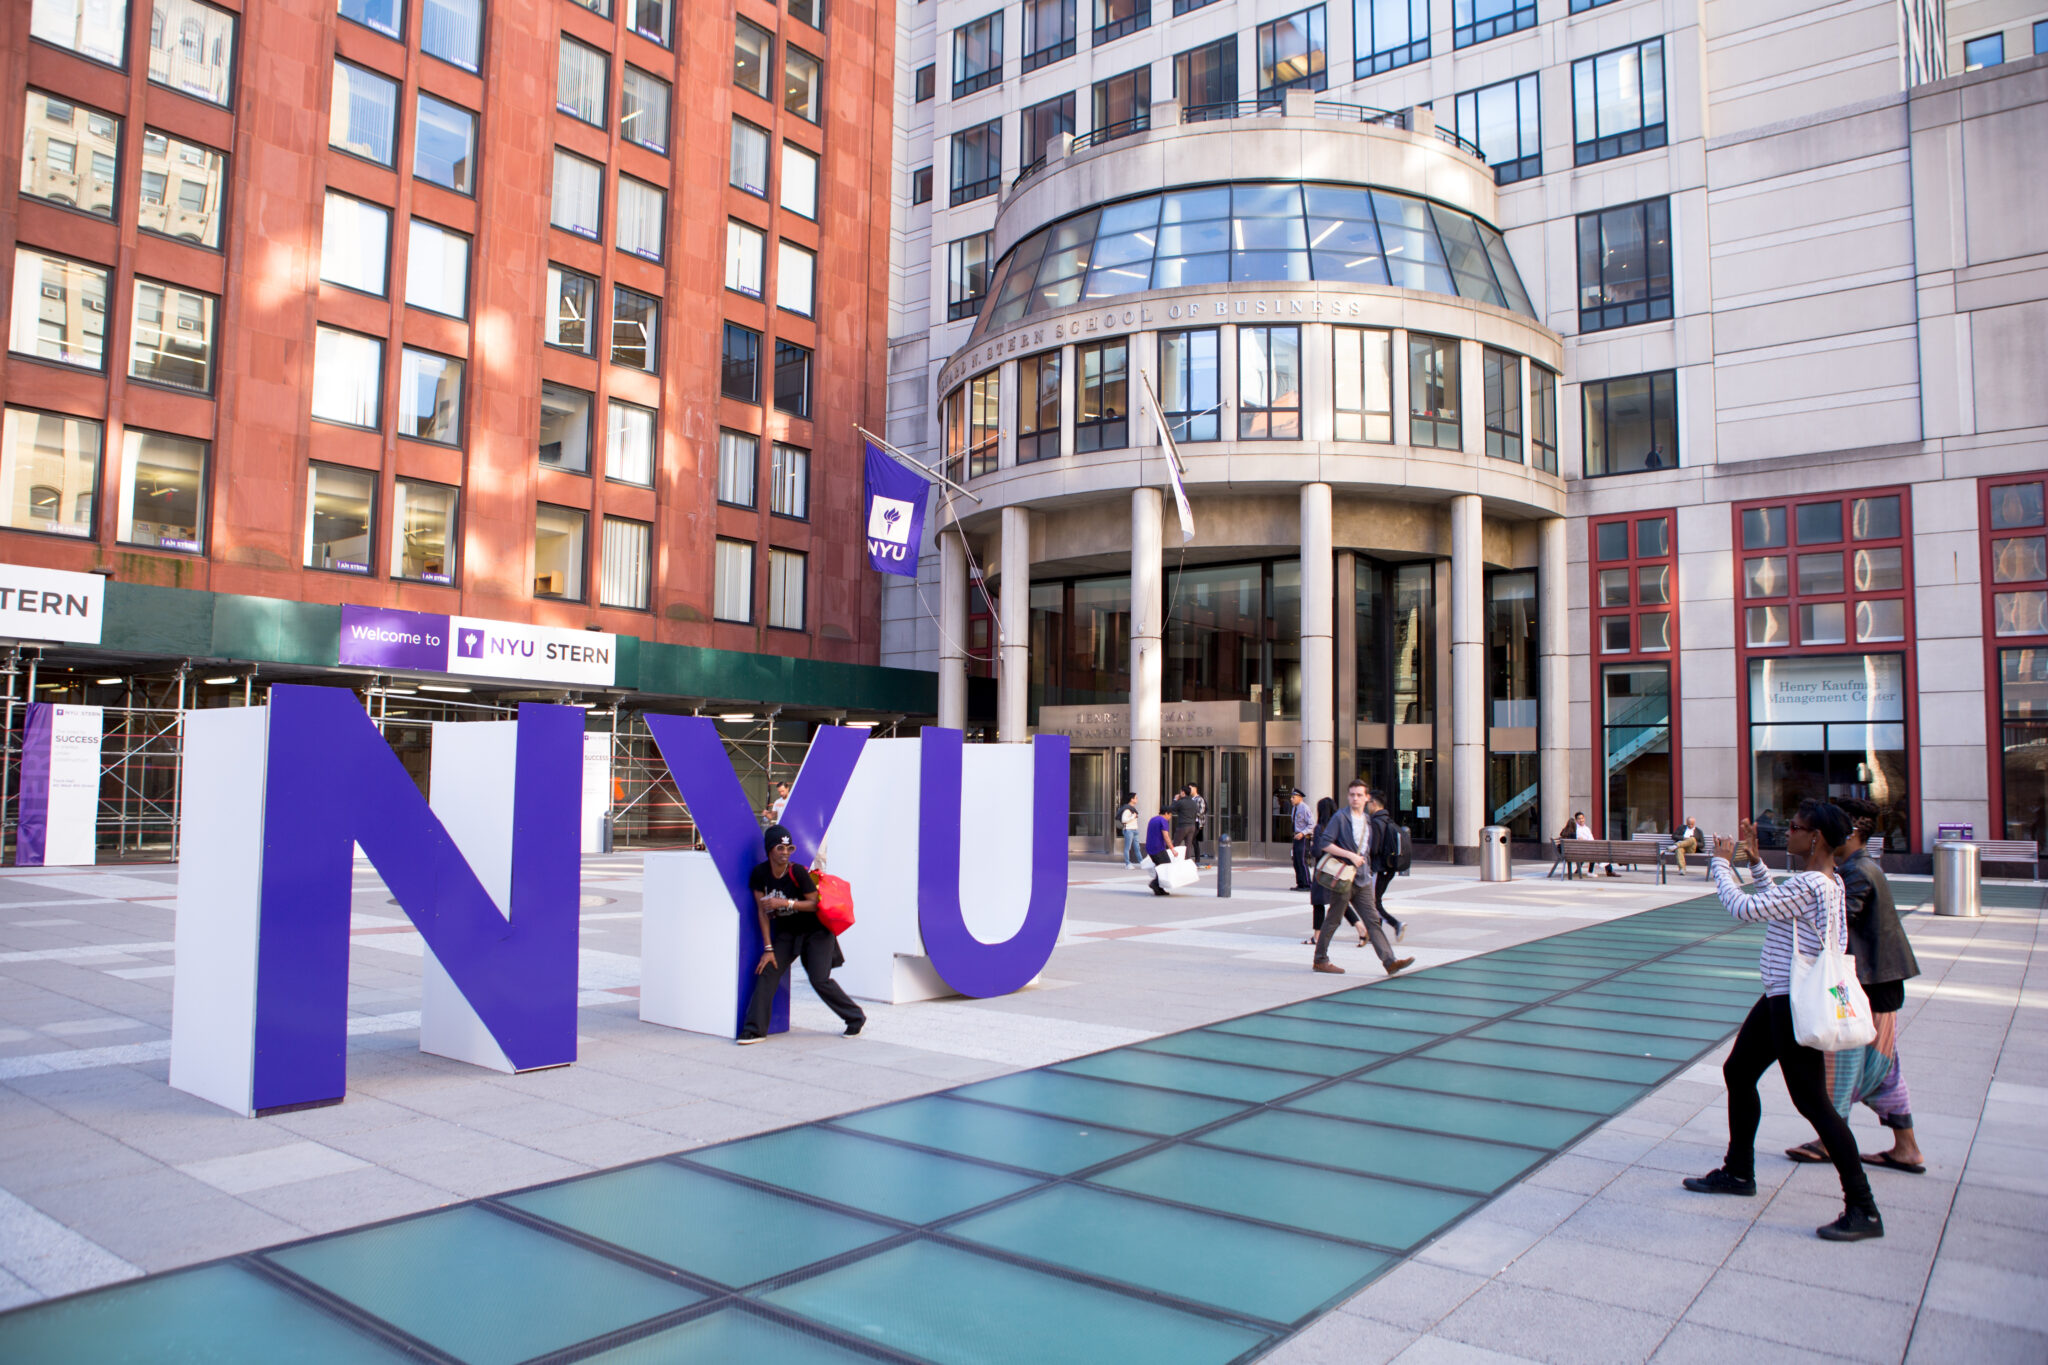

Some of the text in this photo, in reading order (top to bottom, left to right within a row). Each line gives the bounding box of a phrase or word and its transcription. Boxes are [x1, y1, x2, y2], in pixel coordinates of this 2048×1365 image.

[987, 329, 1044, 360] STERN
[1055, 308, 1153, 339] SCHOOL
[1169, 303, 1200, 319] OF
[1215, 299, 1361, 316] BUSINESS
[867, 538, 907, 561] NYU
[0, 587, 88, 617] TERN
[351, 624, 440, 646] Welcome to
[490, 637, 609, 664] NYU STERN
[1780, 679, 1881, 693] Henry Kaufmn
[1769, 691, 1897, 705] Management Ceter
[1076, 712, 1120, 724] HENRY
[55, 735, 99, 744] SUCCESS
[253, 682, 1071, 1116] NYU
